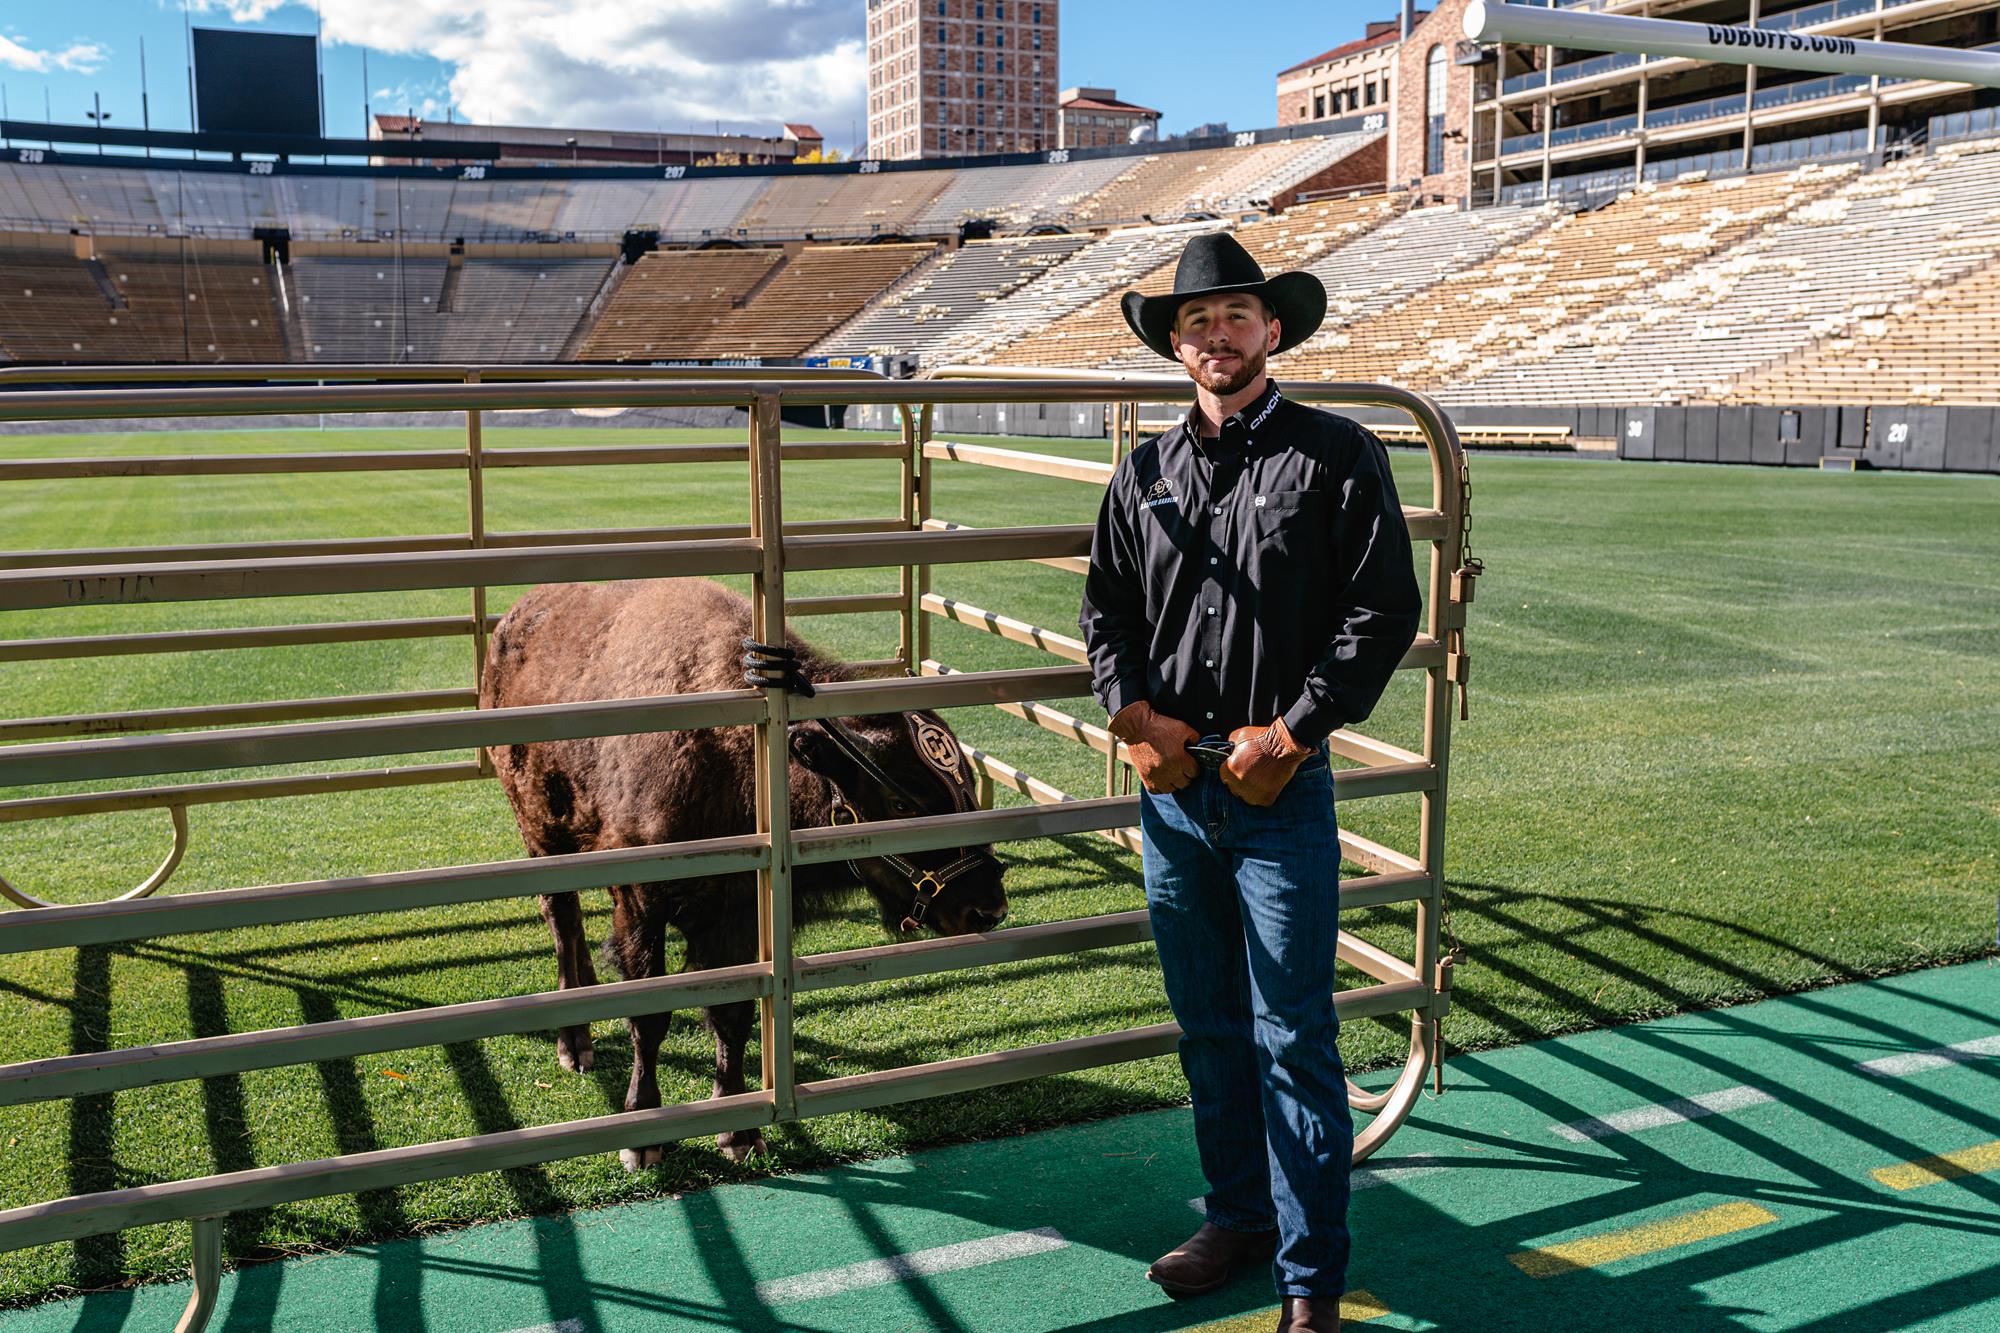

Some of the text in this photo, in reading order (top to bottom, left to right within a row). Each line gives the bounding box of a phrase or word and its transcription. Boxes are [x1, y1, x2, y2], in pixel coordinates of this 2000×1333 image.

[1362, 114, 1385, 131] 203
[1235, 132, 1256, 148] 204
[19, 149, 44, 163] 210
[1048, 150, 1069, 163] 205
[250, 162, 274, 175] 209
[463, 166, 486, 179] 208
[664, 166, 686, 179] 207
[859, 161, 880, 174] 206
[1250, 390, 1282, 430] CINCH
[1628, 421, 1643, 437] 30
[1888, 424, 1908, 443] 20
